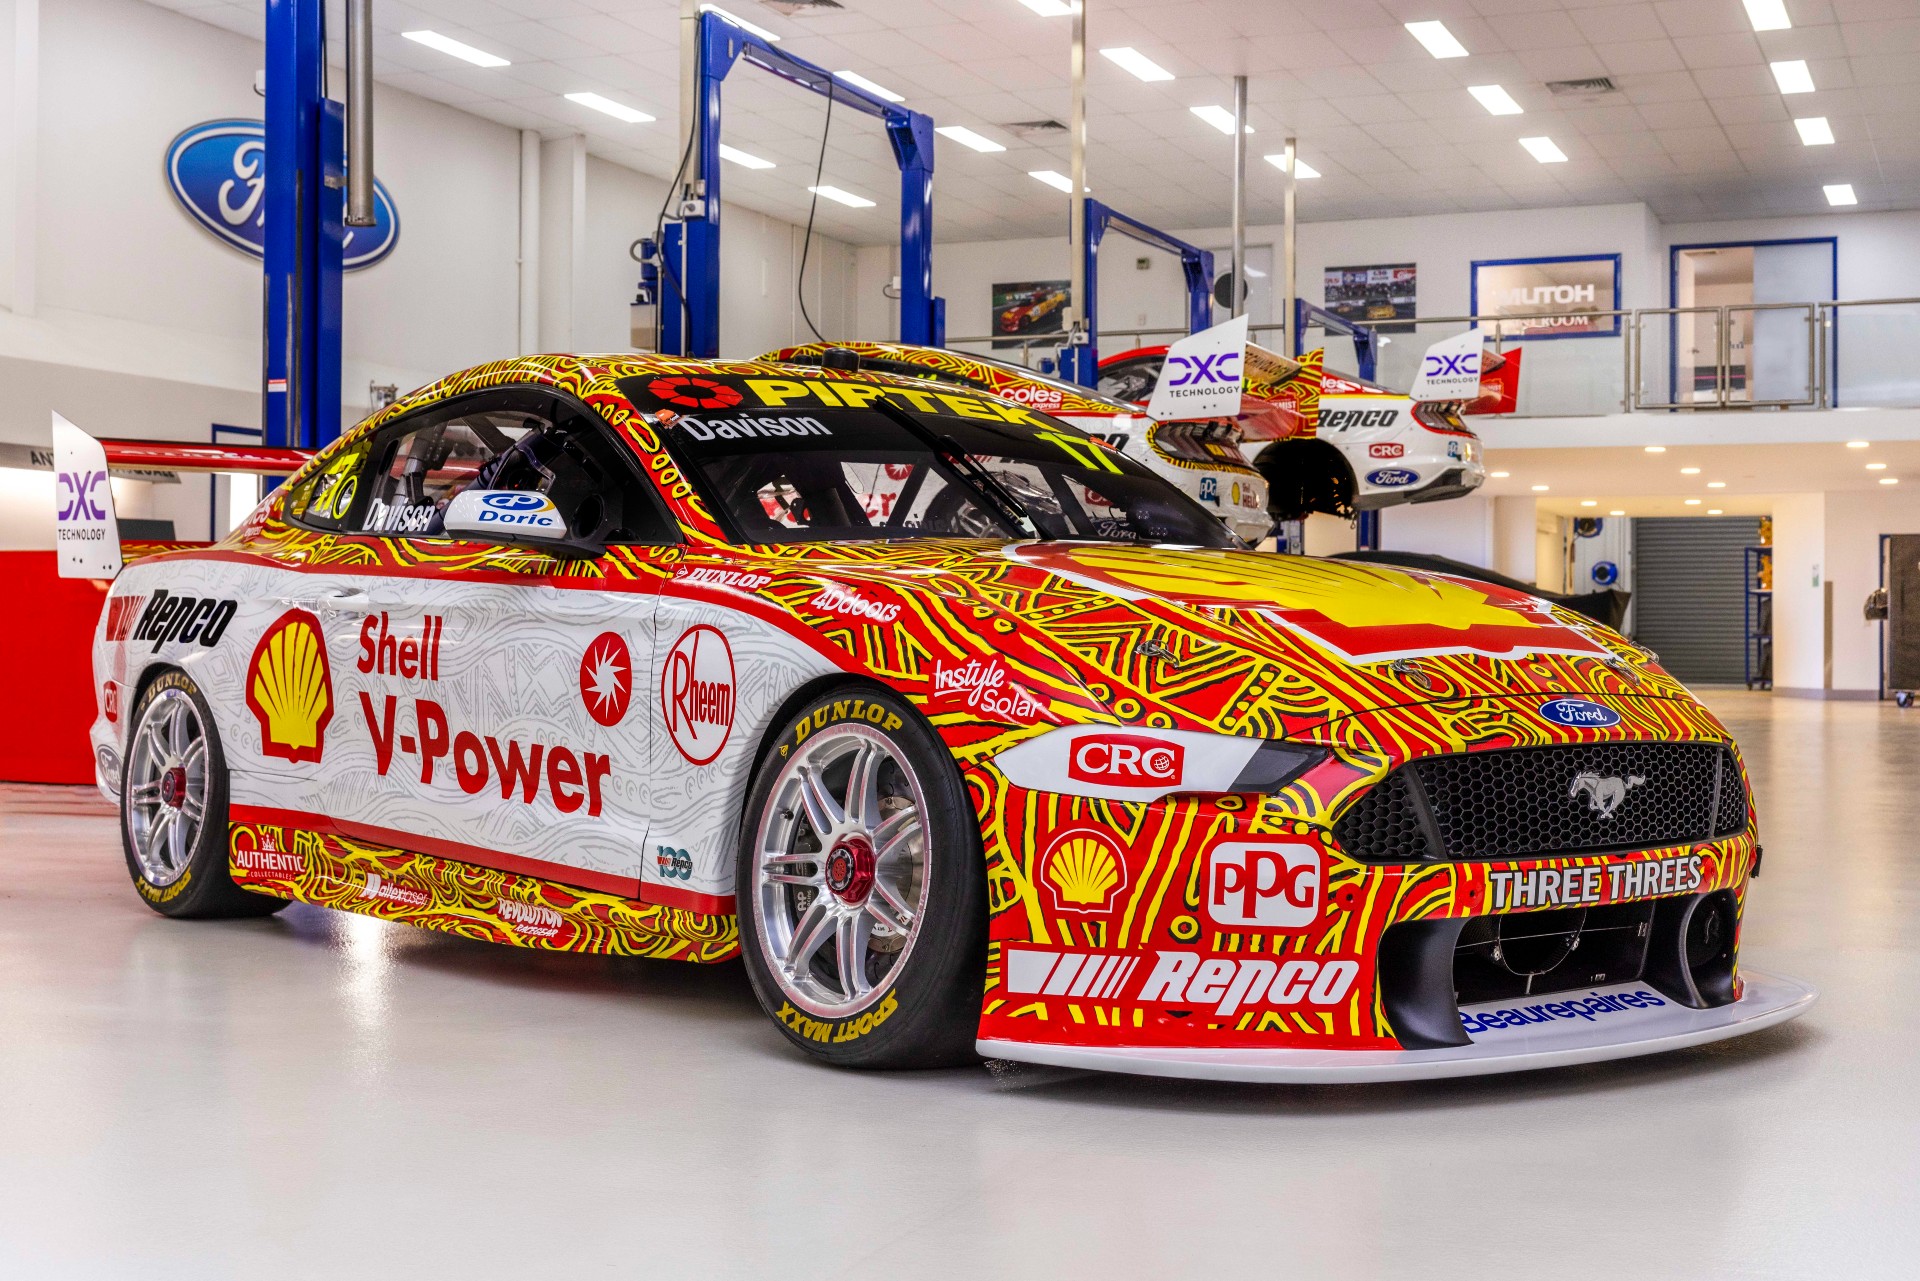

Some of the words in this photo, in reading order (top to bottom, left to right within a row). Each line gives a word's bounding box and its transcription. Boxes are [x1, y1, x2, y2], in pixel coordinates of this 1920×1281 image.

[1499, 283, 1595, 305] MUTOH
[1169, 352, 1239, 386] DXC
[1426, 354, 1478, 377] DXC
[1426, 377, 1479, 385] TECHNOLOGY
[744, 379, 1064, 433] PIRTEK
[1000, 386, 1062, 402] coles
[1031, 402, 1060, 411] express
[1169, 386, 1240, 398] TECHNOLOGY
[678, 414, 833, 441] Davison
[1317, 409, 1399, 432] Repco
[1370, 445, 1402, 457] CRC
[1375, 470, 1411, 484] Ford
[58, 470, 106, 520] DXC
[362, 498, 435, 532] Davison
[478, 510, 553, 527] Doric
[58, 527, 106, 540] TECHNOLOGY
[688, 567, 773, 589] DUNLOP
[133, 589, 238, 654] Repco
[810, 589, 902, 622] 4Ddoors
[357, 610, 443, 681] Shell
[144, 672, 197, 706] DUNLOP
[672, 630, 731, 740] Rheem
[934, 659, 1005, 707] Instyle
[980, 688, 1043, 718] Solar
[1557, 701, 1608, 723] Ford
[795, 699, 904, 746] DUNLOP
[357, 691, 612, 818] V-Power
[1075, 741, 1176, 778] CRC
[236, 850, 306, 873] AUTHENTIC
[657, 845, 693, 881] 100
[671, 857, 693, 870] Repco
[1213, 849, 1316, 919] PPG
[1490, 867, 1600, 908] THREE
[1609, 856, 1702, 899] THREES
[497, 897, 564, 928] REVOLUTION
[513, 923, 559, 938] RACEGEAR
[1137, 949, 1360, 1017] Repco
[775, 1000, 834, 1043] MAXX
[832, 987, 899, 1043] SPORT
[1460, 989, 1667, 1034] Beaurepaires
